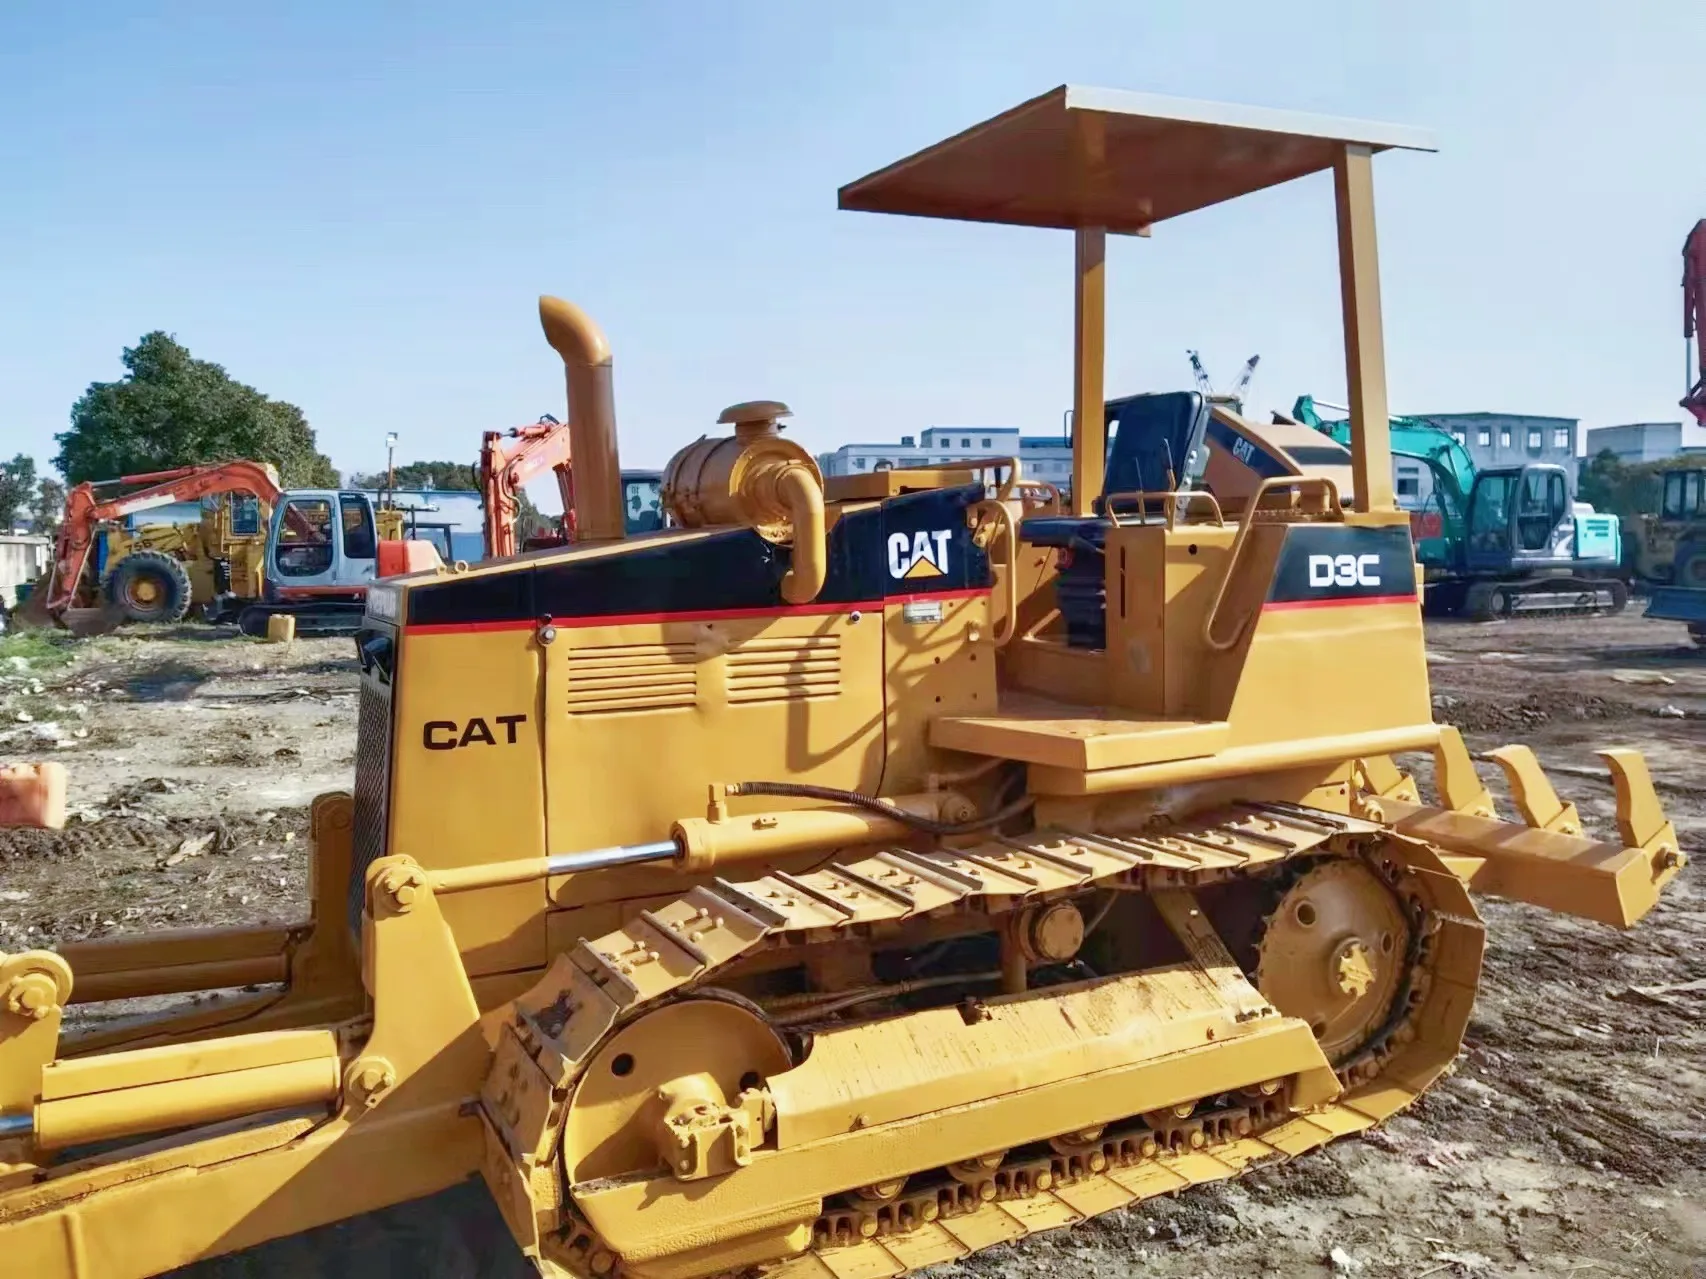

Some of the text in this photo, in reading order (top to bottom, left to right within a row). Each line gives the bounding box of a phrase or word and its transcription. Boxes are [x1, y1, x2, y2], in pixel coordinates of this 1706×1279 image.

[1233, 436, 1255, 464] CAT
[888, 529, 952, 579] CAT
[1309, 554, 1381, 588] D3C
[423, 714, 527, 750] CAT
